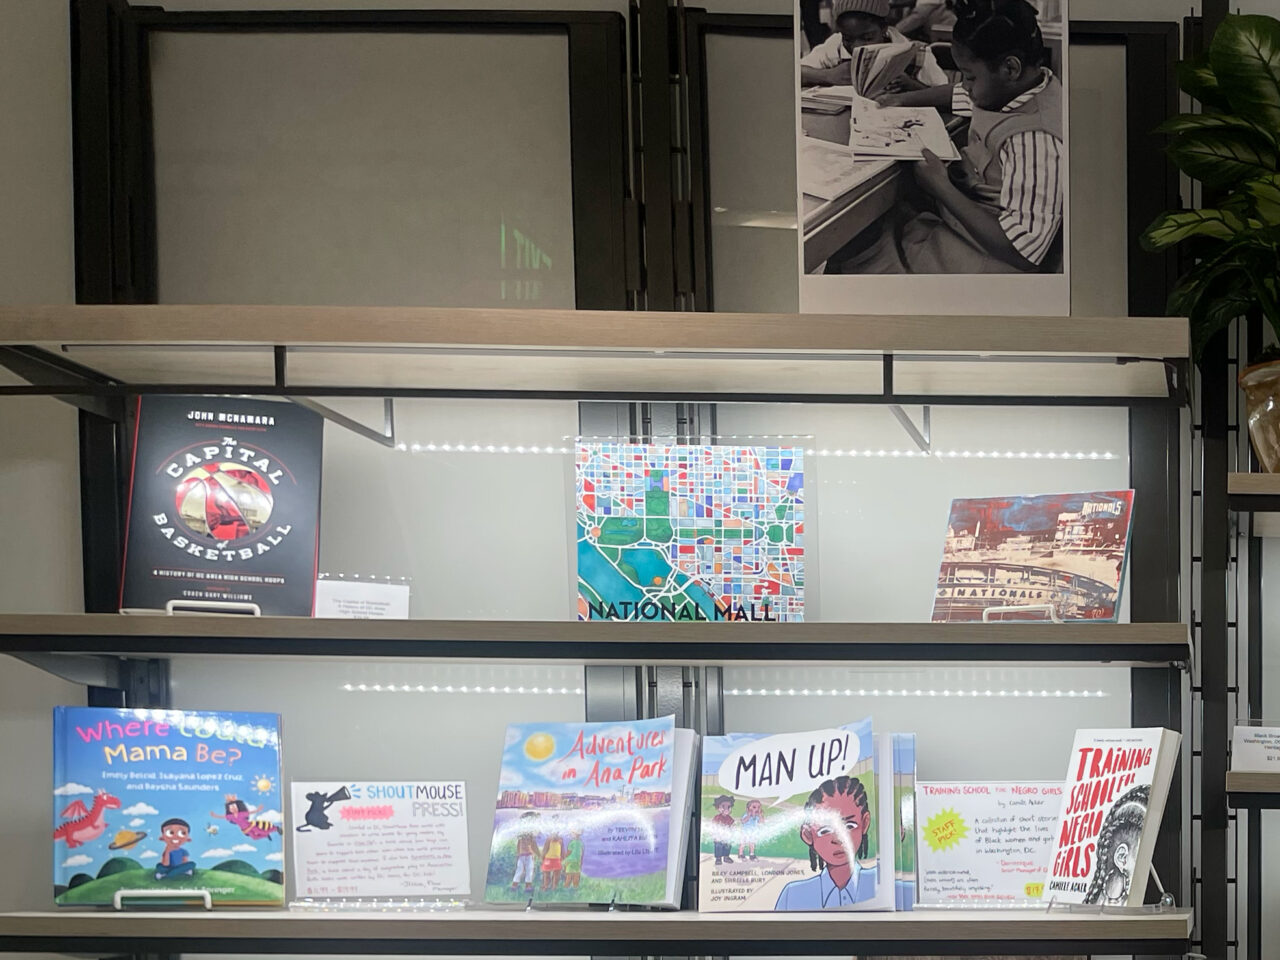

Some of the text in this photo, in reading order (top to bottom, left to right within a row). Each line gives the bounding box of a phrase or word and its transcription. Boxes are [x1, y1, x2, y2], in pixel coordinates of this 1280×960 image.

[187, 410, 275, 425] JOHN MCNAMARA
[166, 446, 284, 485] CAPITAL
[1082, 501, 1122, 515] NATIONALS
[153, 513, 292, 561] BASKETBALL
[957, 588, 1042, 599] NATIONALS
[588, 602, 776, 621] NATIONAL MALL
[76, 720, 170, 743] Where
[104, 743, 242, 766] Mama Be?
[557, 730, 666, 763] Adventures
[584, 752, 667, 788] Ana Park
[735, 734, 849, 790] MAN UP!
[923, 786, 960, 795] TRAINING
[963, 786, 991, 795] SCHOOL
[1011, 786, 1038, 794] NEGRO
[1042, 787, 1063, 795] GIRLS
[1066, 773, 1136, 815] SCHOOL FOR
[412, 802, 463, 817] PRESS!
[1059, 810, 1103, 848] NEGRO
